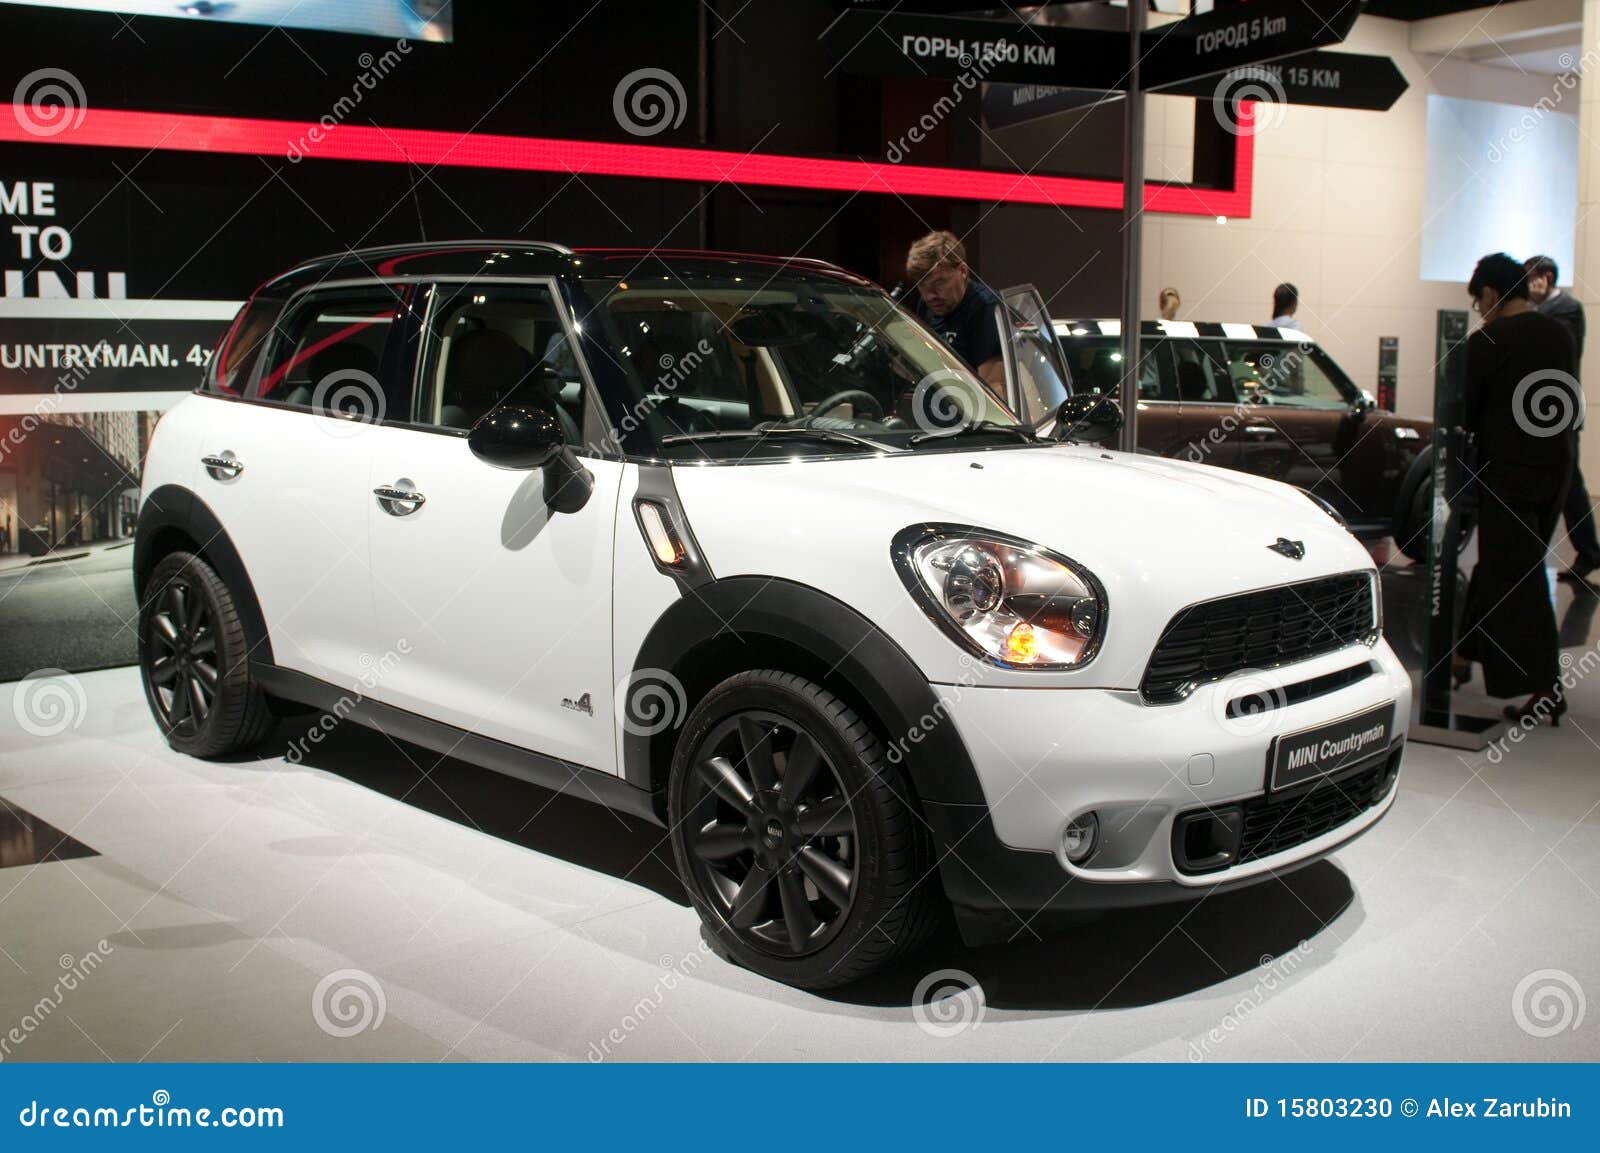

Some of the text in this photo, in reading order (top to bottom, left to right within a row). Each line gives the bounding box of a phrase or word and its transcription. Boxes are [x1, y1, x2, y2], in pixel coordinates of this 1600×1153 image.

[902, 35, 964, 58] ГОРЫ
[971, 42, 1018, 62] 1500
[1196, 22, 1248, 55] ГОРОД
[1251, 20, 1261, 40] 5
[1288, 68, 1308, 85] 15
[12, 225, 72, 260] TO
[1431, 564, 1442, 617] MINI
[1287, 724, 1384, 770] MINI Countryman
